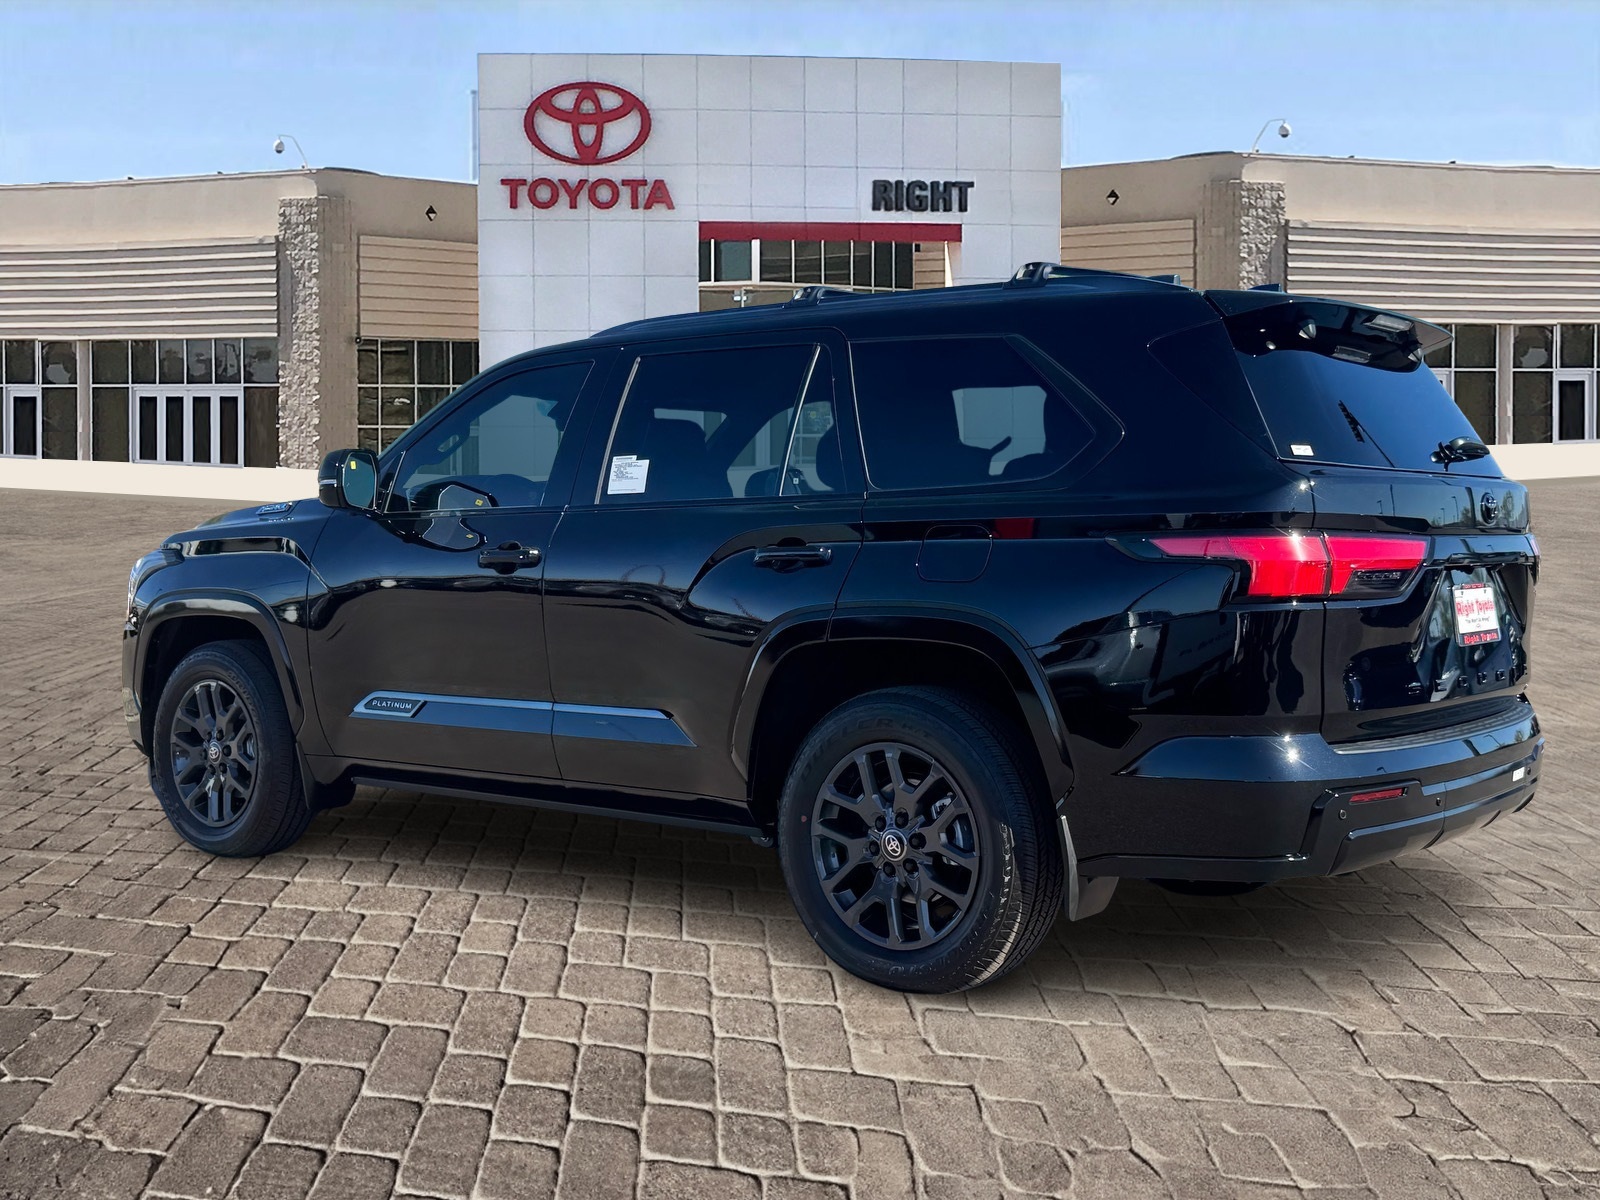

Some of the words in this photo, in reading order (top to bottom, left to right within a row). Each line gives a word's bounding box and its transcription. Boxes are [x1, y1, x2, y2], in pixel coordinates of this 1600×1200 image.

[500, 177, 676, 210] TOYOTA
[872, 179, 975, 212] RIGHT
[1455, 601, 1475, 618] Right
[1475, 598, 1495, 615] Toyota
[372, 700, 412, 709] PLATINUM
